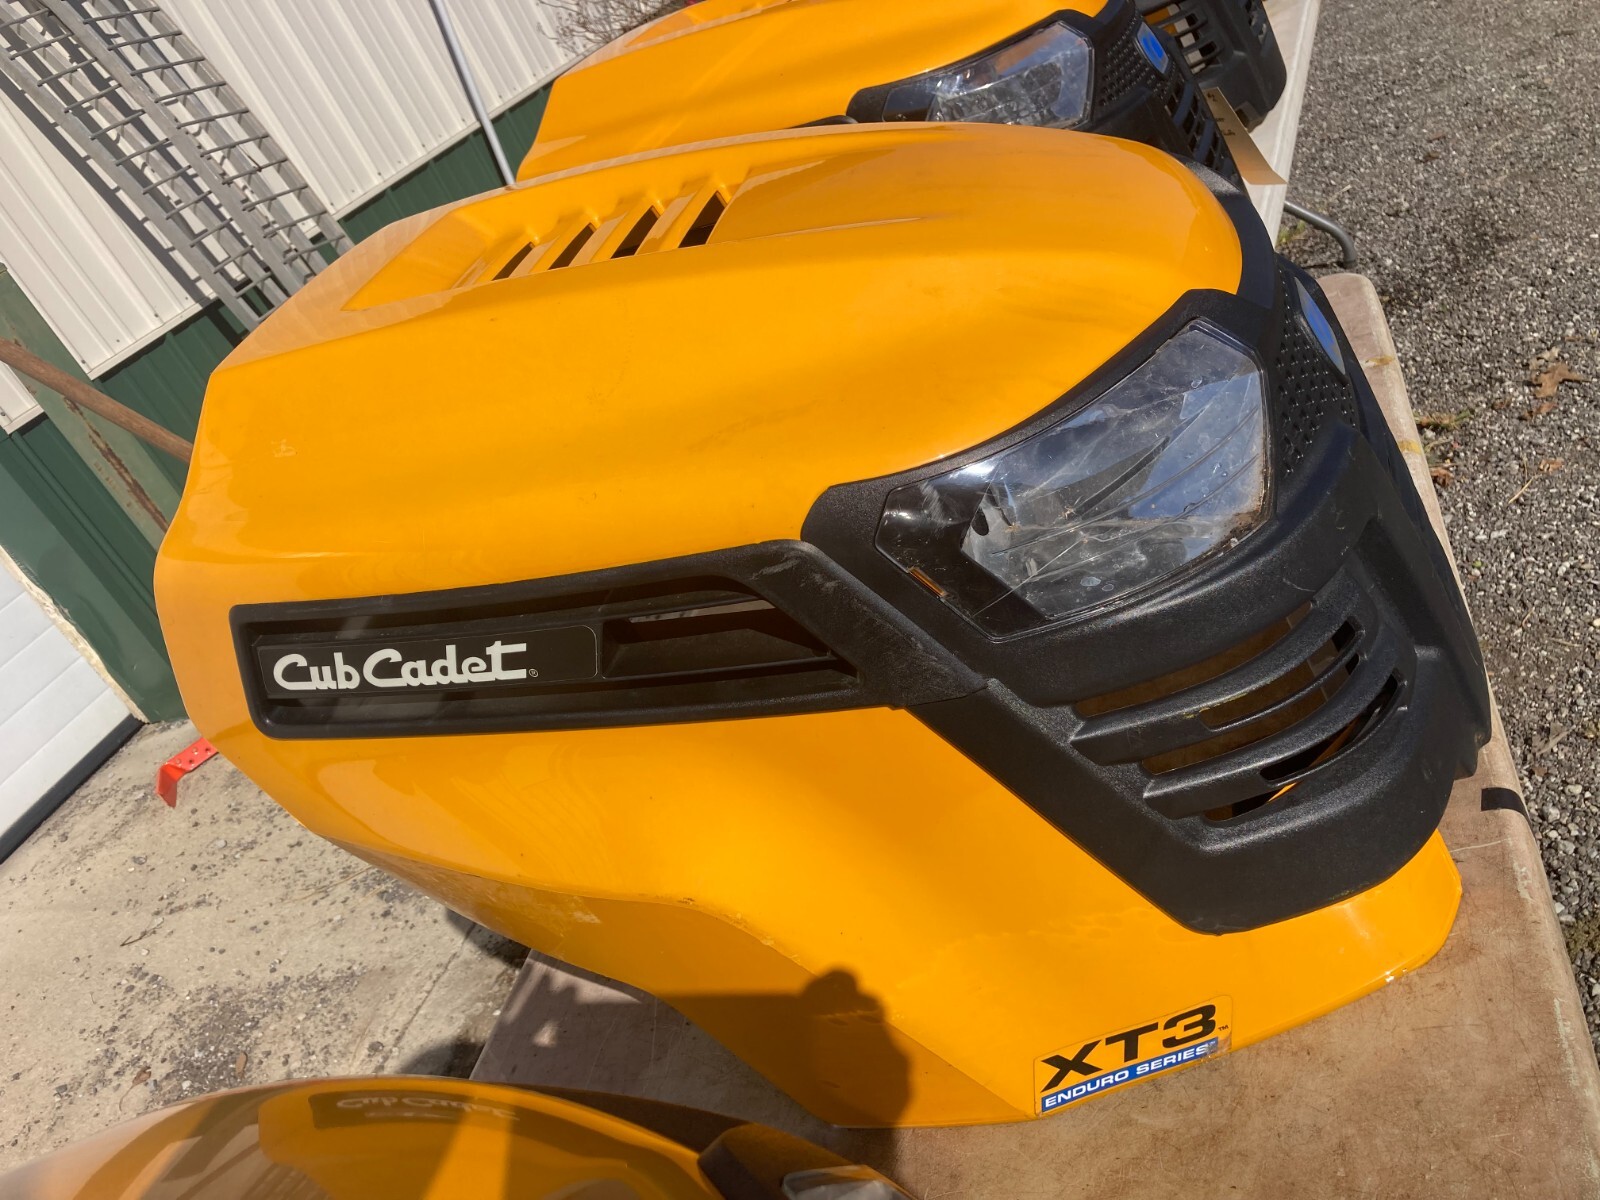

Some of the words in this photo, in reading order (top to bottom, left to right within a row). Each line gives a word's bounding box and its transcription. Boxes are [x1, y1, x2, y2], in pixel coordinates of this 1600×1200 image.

[272, 652, 360, 691] Cub
[363, 640, 527, 688] Cadet
[1040, 1004, 1217, 1093] XT3
[1045, 1070, 1130, 1108] ENDURO
[1136, 1043, 1209, 1076] SERIES
